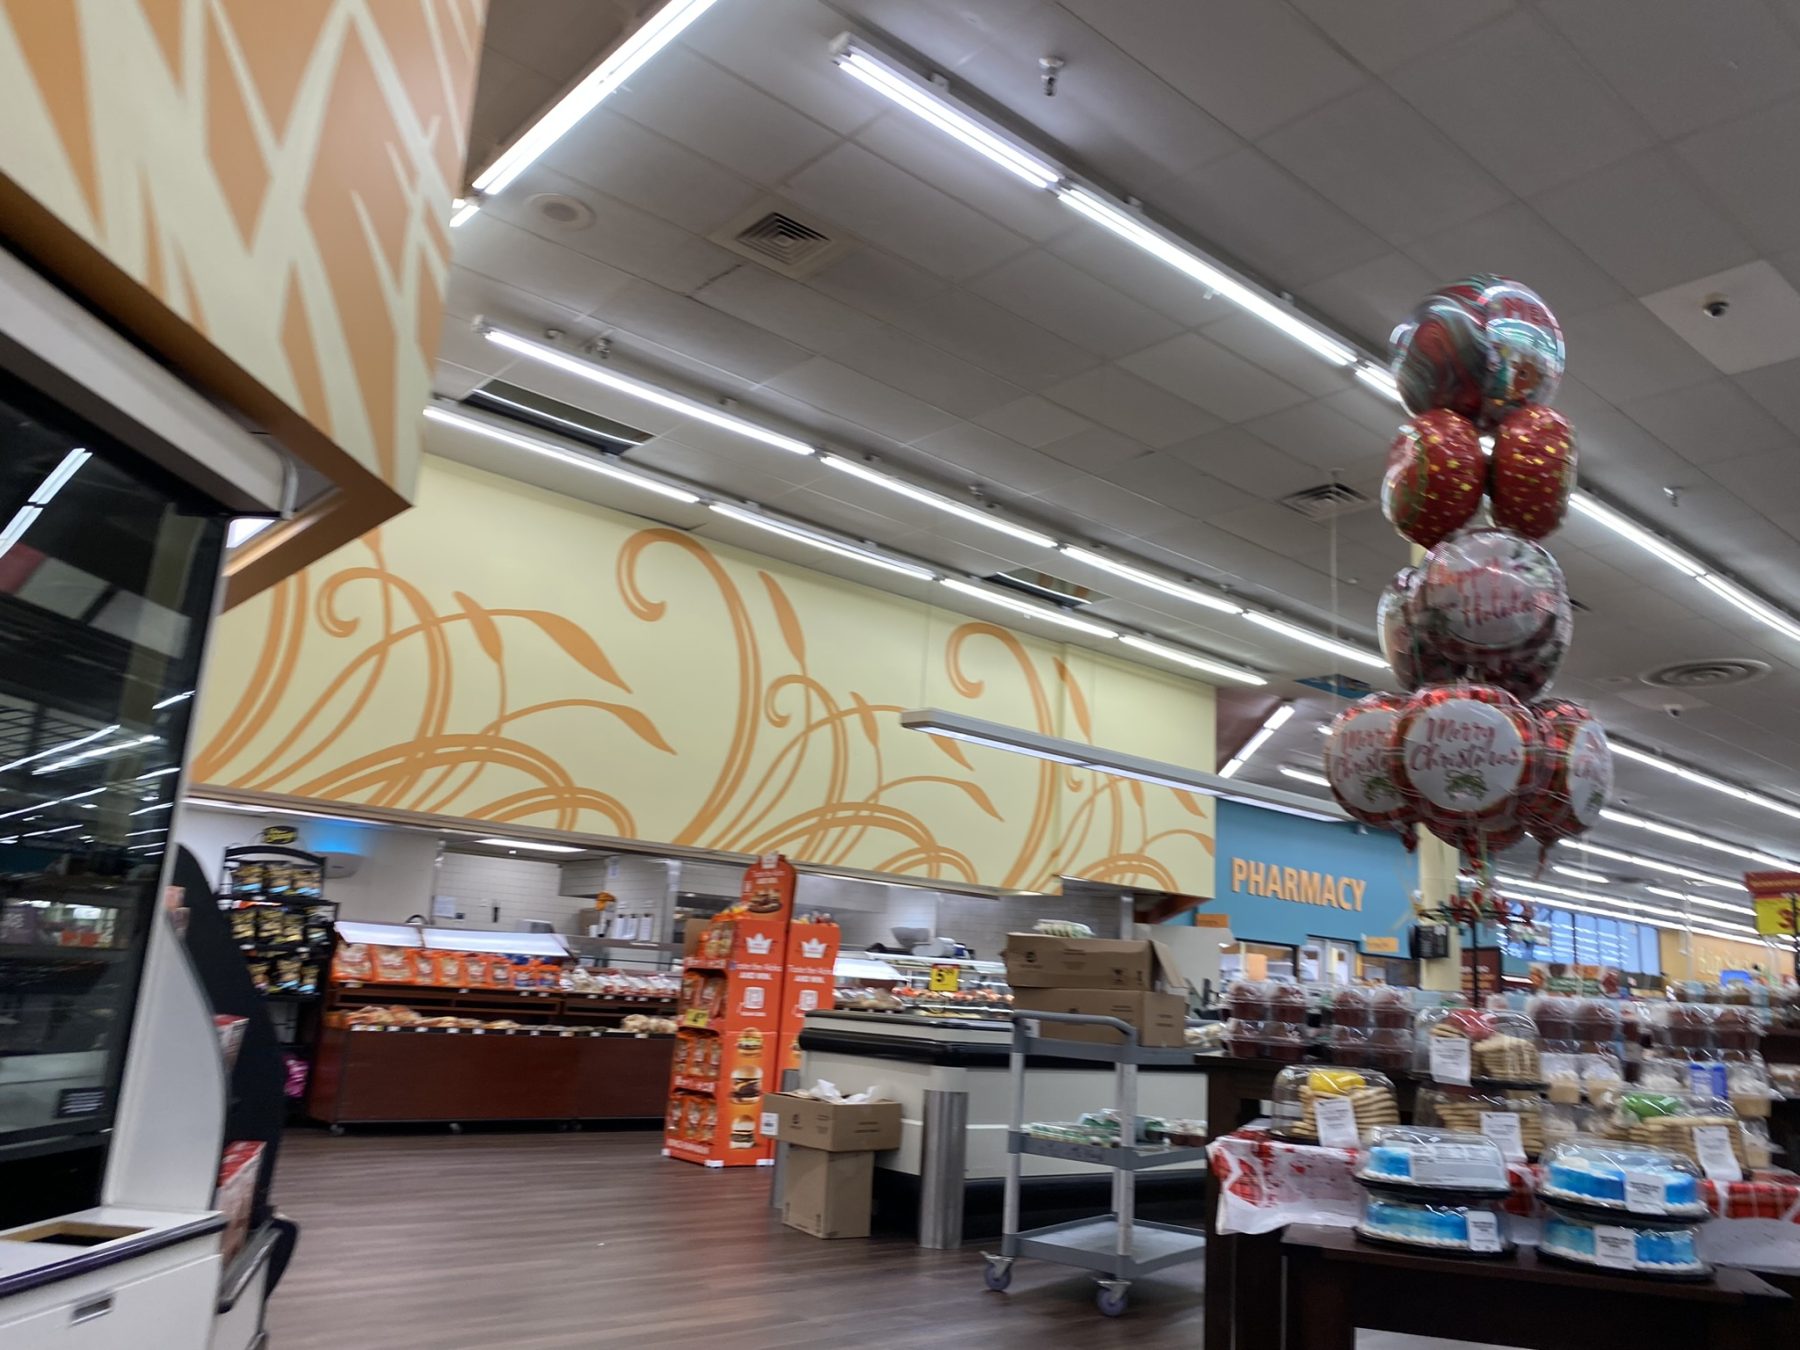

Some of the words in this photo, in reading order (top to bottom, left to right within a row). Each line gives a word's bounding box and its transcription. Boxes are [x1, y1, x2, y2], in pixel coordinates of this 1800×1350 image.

[1342, 728, 1394, 755] Merr
[1427, 716, 1496, 745] Merry
[1411, 743, 1520, 772] Christmas
[1232, 857, 1366, 912] PHARMACY
